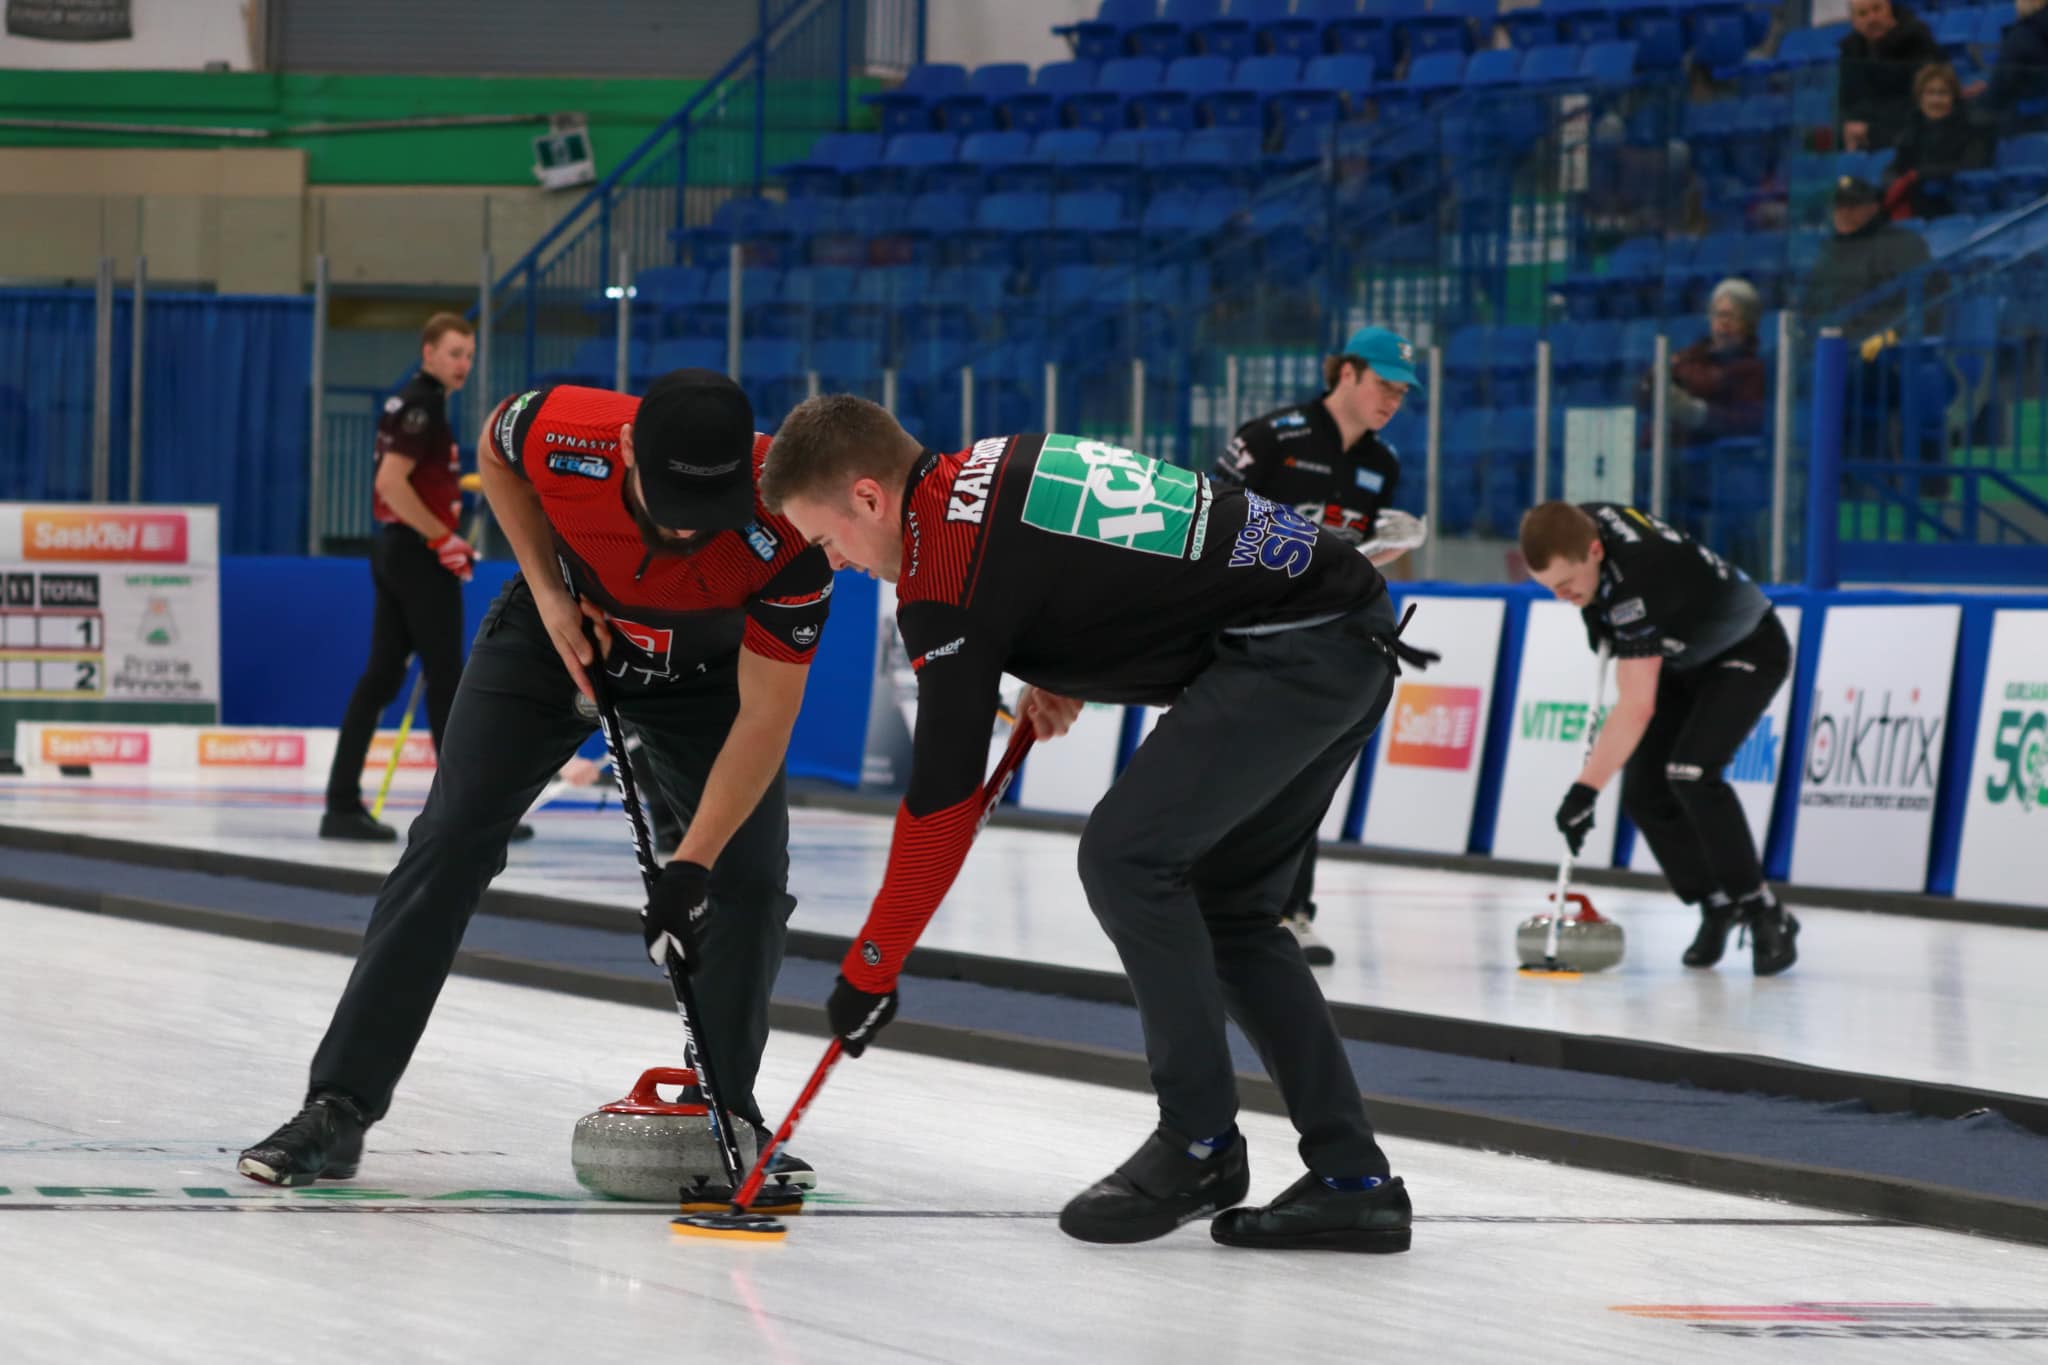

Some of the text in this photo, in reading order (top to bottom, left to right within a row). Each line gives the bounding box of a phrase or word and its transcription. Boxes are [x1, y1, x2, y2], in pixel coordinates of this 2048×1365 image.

[545, 432, 616, 451] DYNASTY
[35, 523, 136, 549] SaskTel
[43, 582, 94, 597] TOTAL
[76, 620, 93, 646] 1
[76, 662, 96, 690] 2
